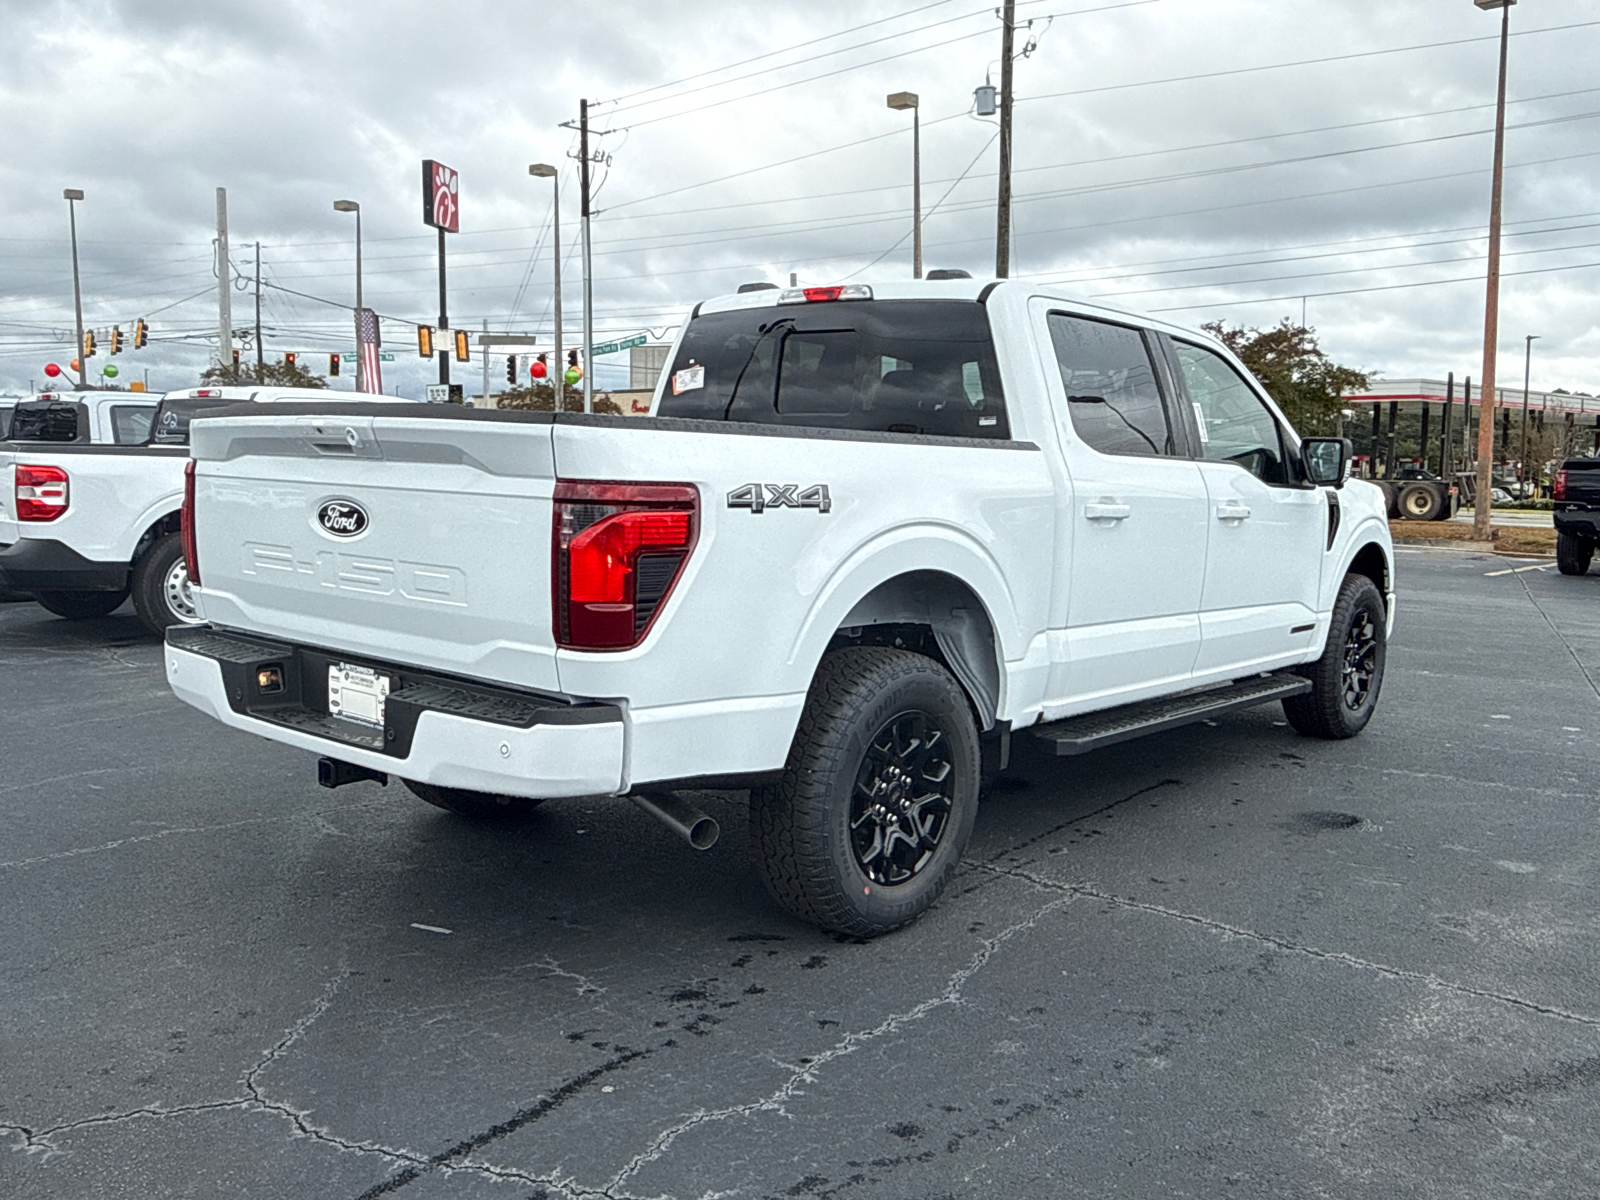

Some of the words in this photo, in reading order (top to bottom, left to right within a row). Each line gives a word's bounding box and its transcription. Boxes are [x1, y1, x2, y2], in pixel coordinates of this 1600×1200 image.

[324, 504, 358, 531] Ford
[242, 541, 468, 607] F-150
[863, 681, 940, 732] GOOD
